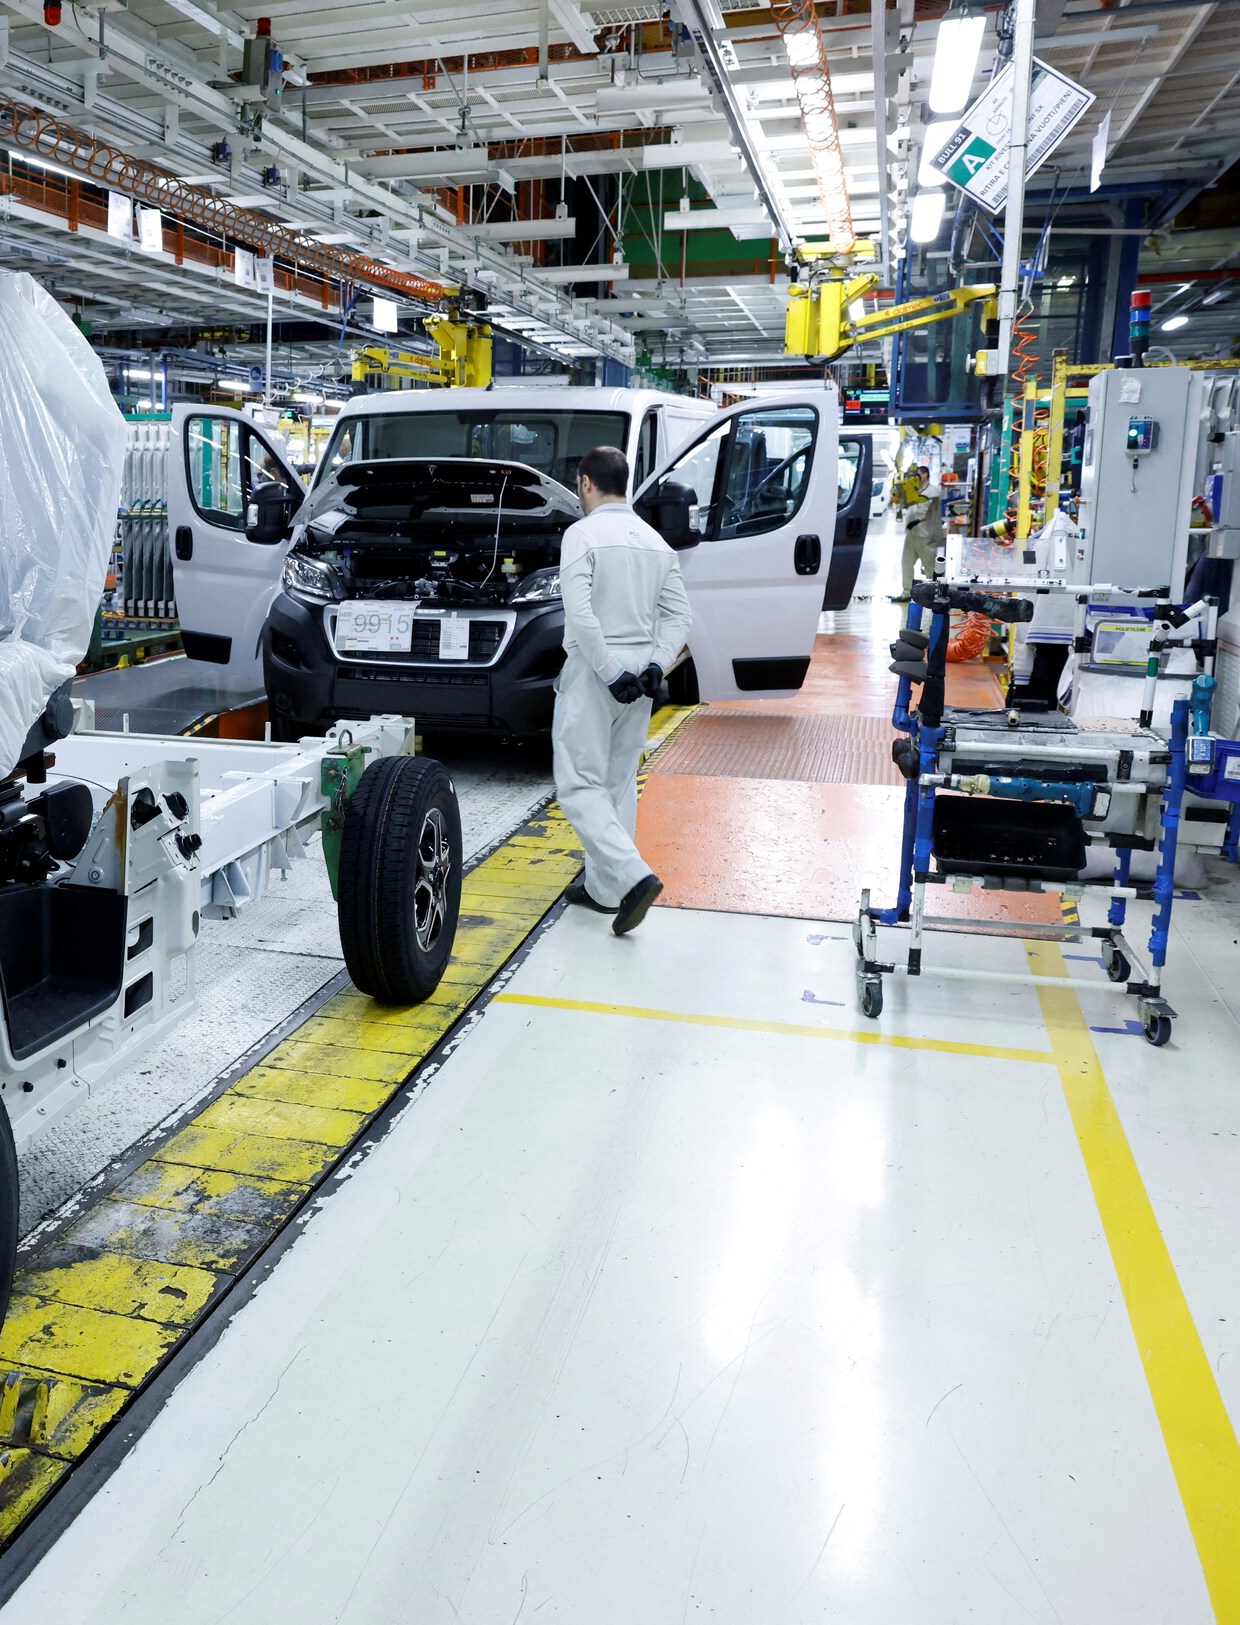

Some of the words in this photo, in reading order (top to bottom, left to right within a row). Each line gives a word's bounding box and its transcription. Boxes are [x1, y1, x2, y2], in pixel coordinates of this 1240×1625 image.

[938, 143, 958, 164] BULL
[953, 131, 967, 145] 91
[979, 173, 1001, 197] RITIRA
[1035, 89, 1073, 134] VUOTI/PIENI
[960, 153, 986, 175] A
[985, 158, 996, 171] KIT
[354, 613, 411, 635] 9915
